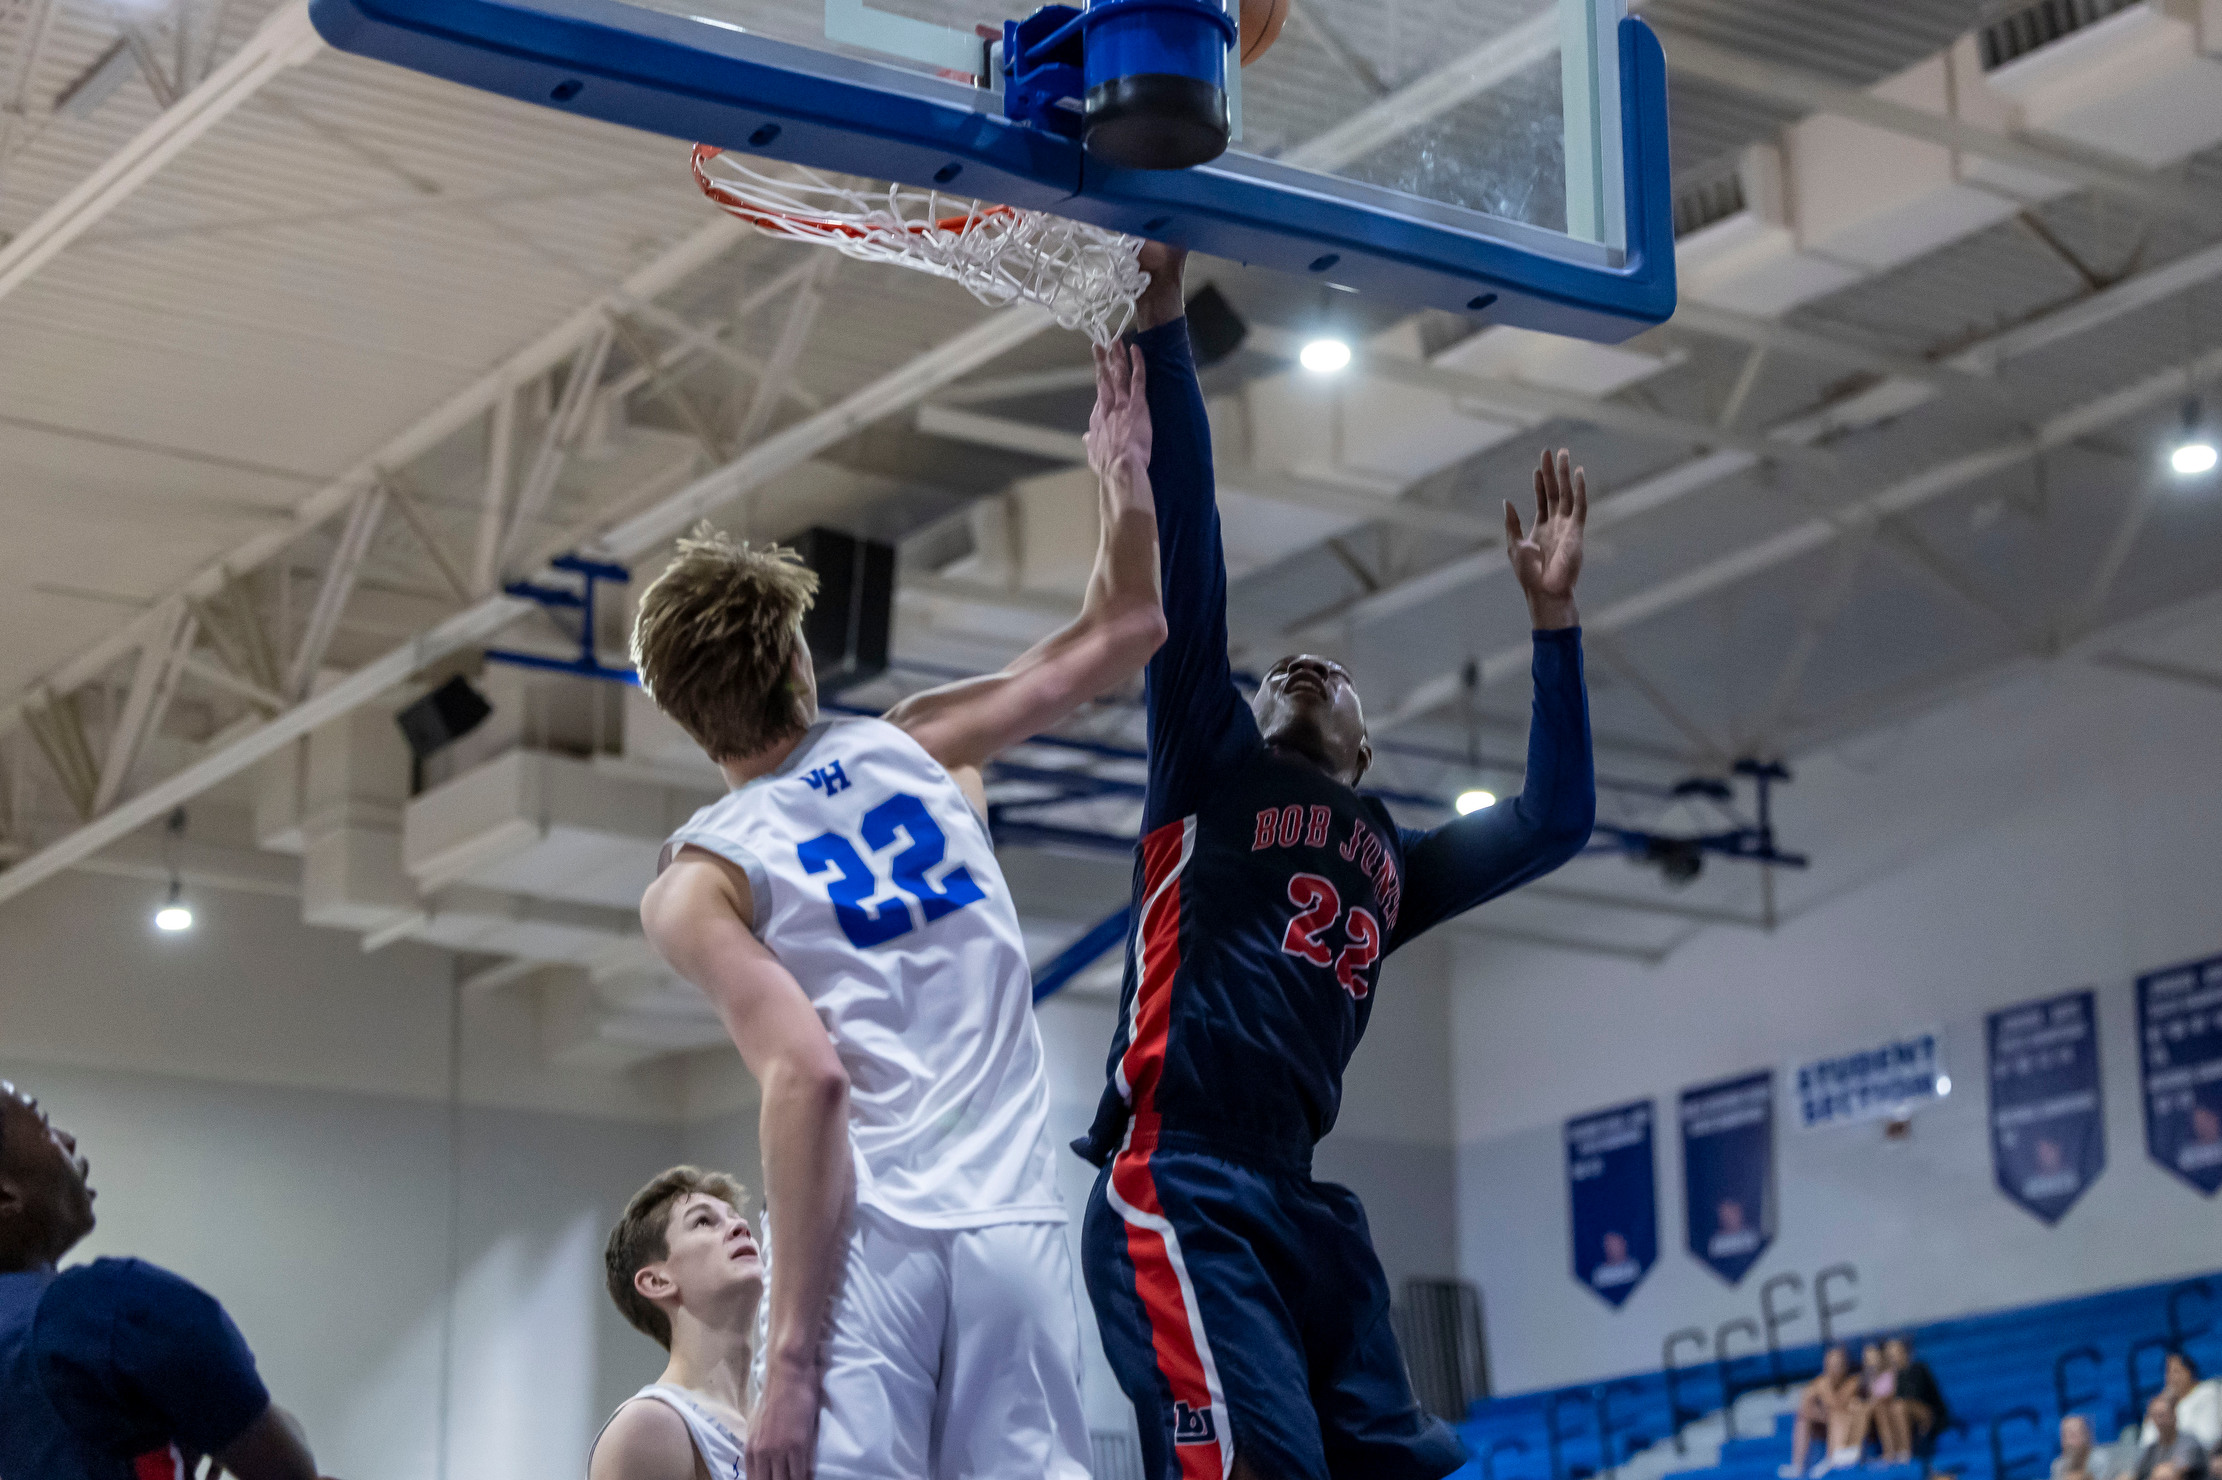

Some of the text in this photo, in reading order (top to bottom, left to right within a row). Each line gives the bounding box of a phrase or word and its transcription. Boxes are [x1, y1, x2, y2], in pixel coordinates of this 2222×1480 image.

[796, 792, 987, 950] 22
[1251, 804, 1332, 852] BOB
[1281, 871, 1381, 1000] 22
